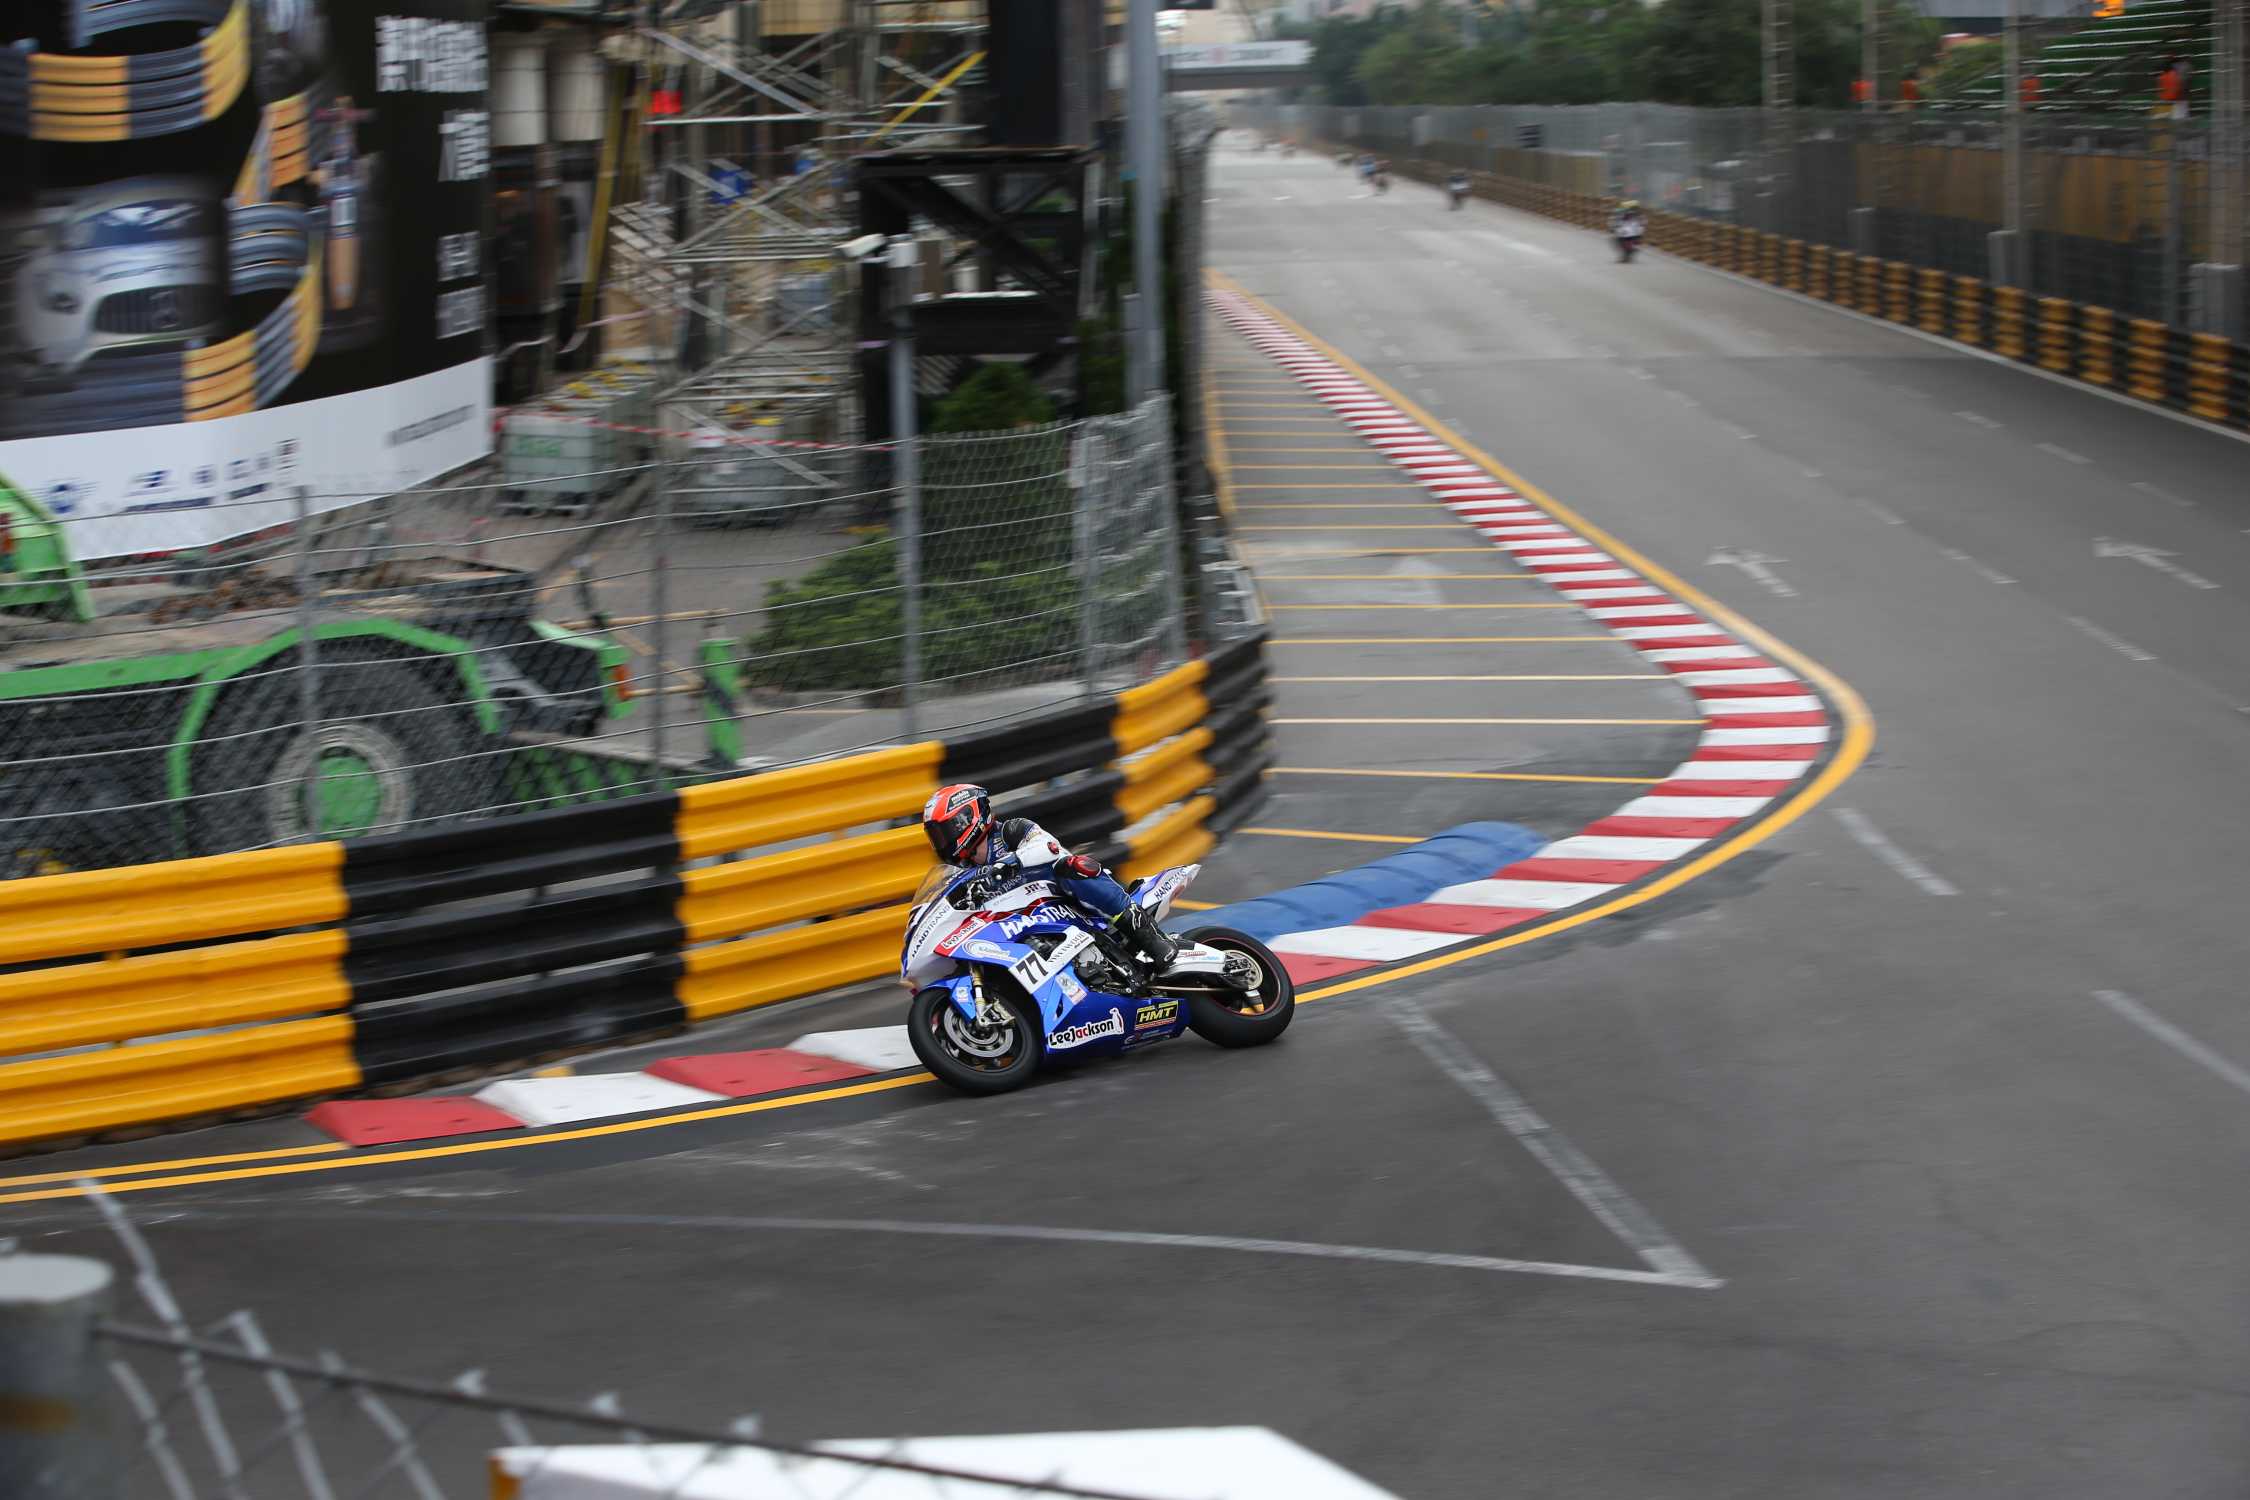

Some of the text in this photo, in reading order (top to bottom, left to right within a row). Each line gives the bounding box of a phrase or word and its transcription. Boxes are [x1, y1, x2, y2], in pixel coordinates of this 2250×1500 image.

[1015, 953, 1049, 985] 77
[1139, 1006, 1175, 1023] HMT
[1048, 1020, 1115, 1046] LeeJackson
